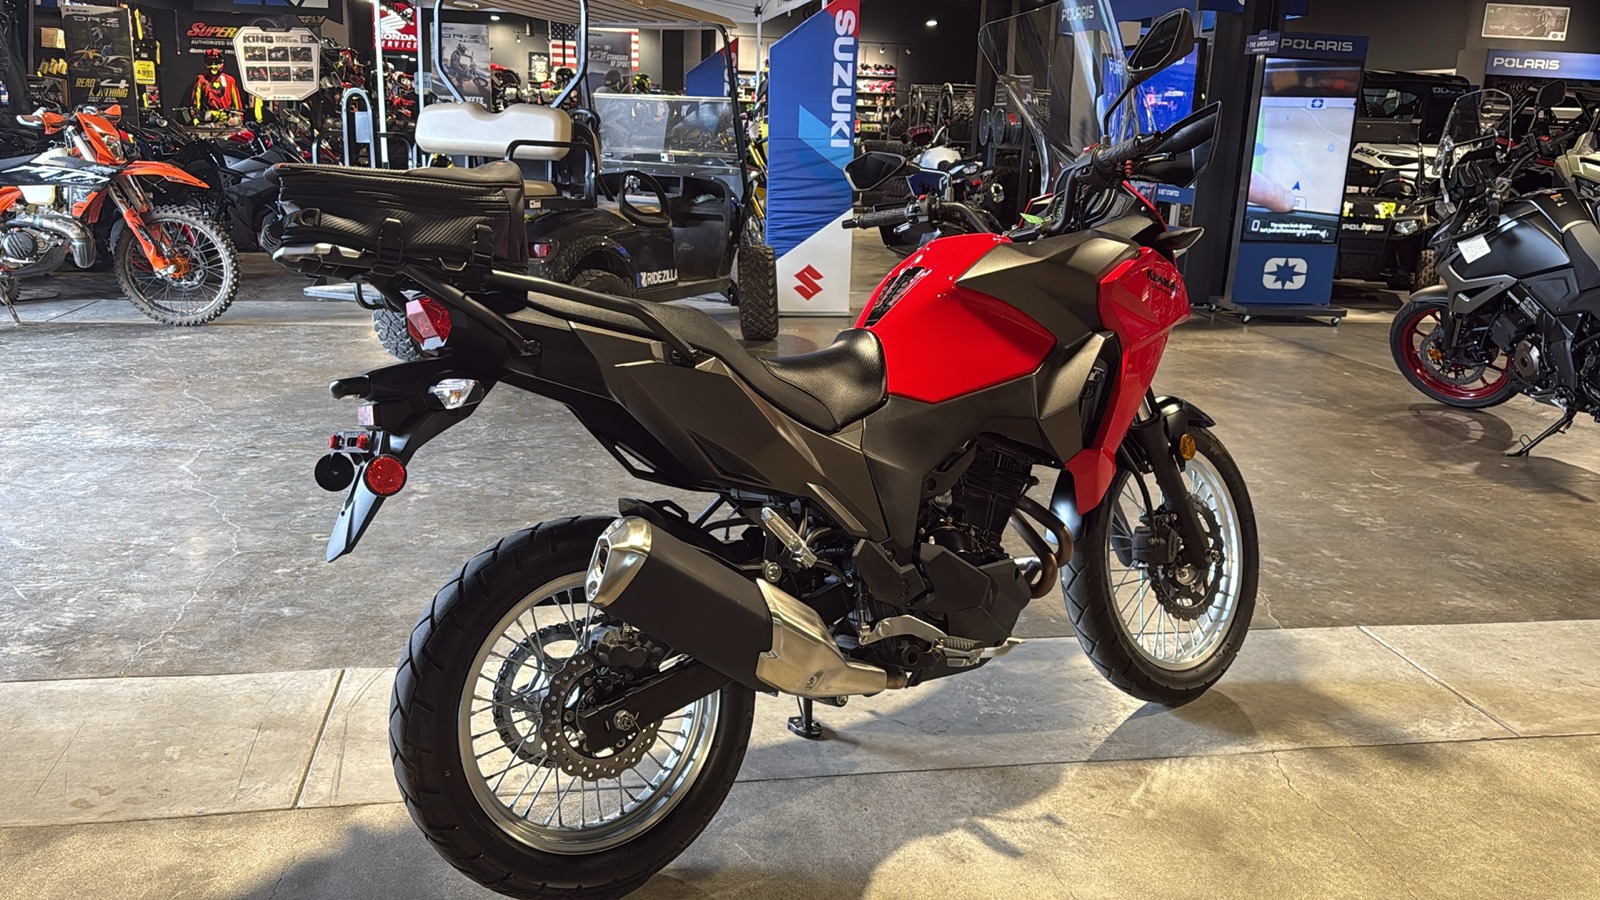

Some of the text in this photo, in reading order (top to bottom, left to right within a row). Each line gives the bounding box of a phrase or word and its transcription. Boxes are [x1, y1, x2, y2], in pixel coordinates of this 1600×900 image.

[1061, 5, 1094, 22] POLARIS
[375, 41, 418, 49] ERVICE
[1280, 38, 1353, 52] POLARIS
[1493, 57, 1560, 70] POLARIS
[830, 9, 856, 148] SUZUKI
[647, 268, 678, 285] RIDEZILLA
